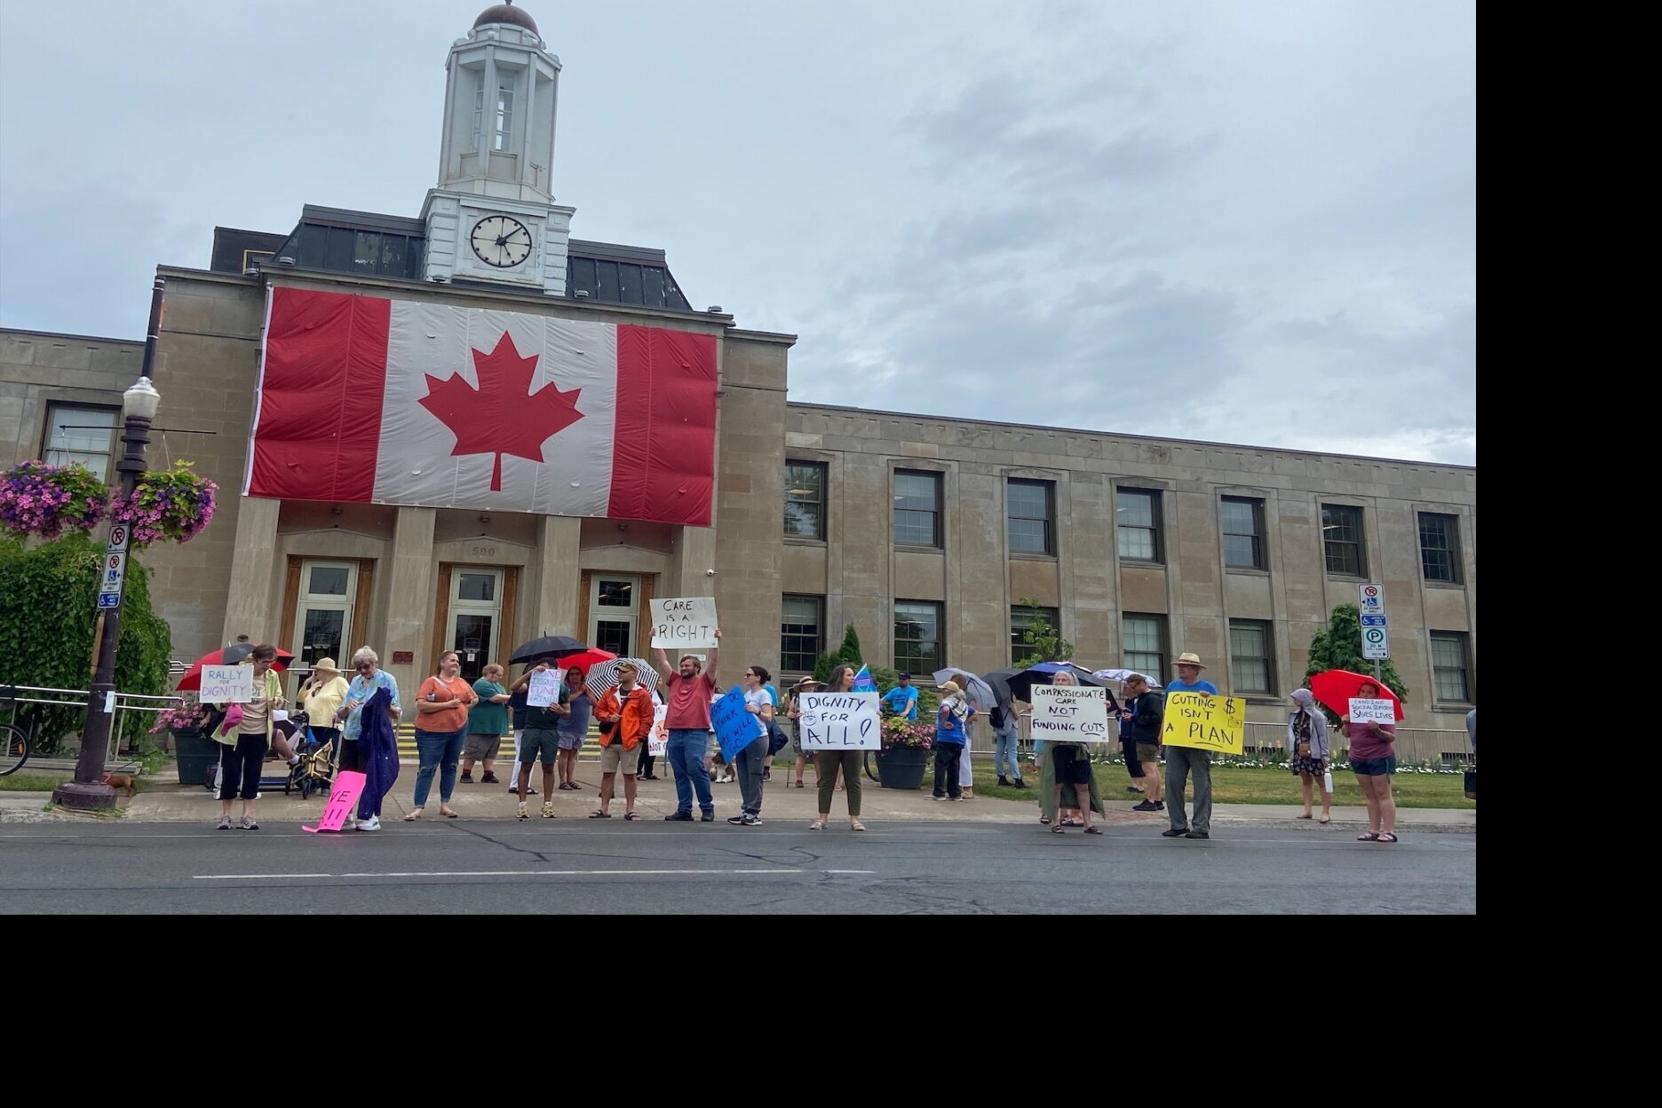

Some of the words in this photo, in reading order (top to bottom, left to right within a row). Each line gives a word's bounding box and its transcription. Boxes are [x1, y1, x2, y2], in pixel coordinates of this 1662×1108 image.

[663, 600, 693, 611] CARE
[658, 624, 709, 640] RIGHT
[208, 670, 243, 680] RALLY
[201, 685, 245, 697] DIGNITY
[1034, 686, 1104, 699] COMPASSIONATE
[808, 696, 866, 712] DIGNITY
[1171, 694, 1216, 708] CUTTING
[821, 712, 849, 721] FOR
[1048, 706, 1079, 715] NOT
[807, 719, 872, 745] ALL!
[1032, 719, 1075, 731] FUNDING
[1080, 722, 1105, 732] CUTS
[1165, 722, 1173, 732] A
[1189, 722, 1234, 745] PLAN
